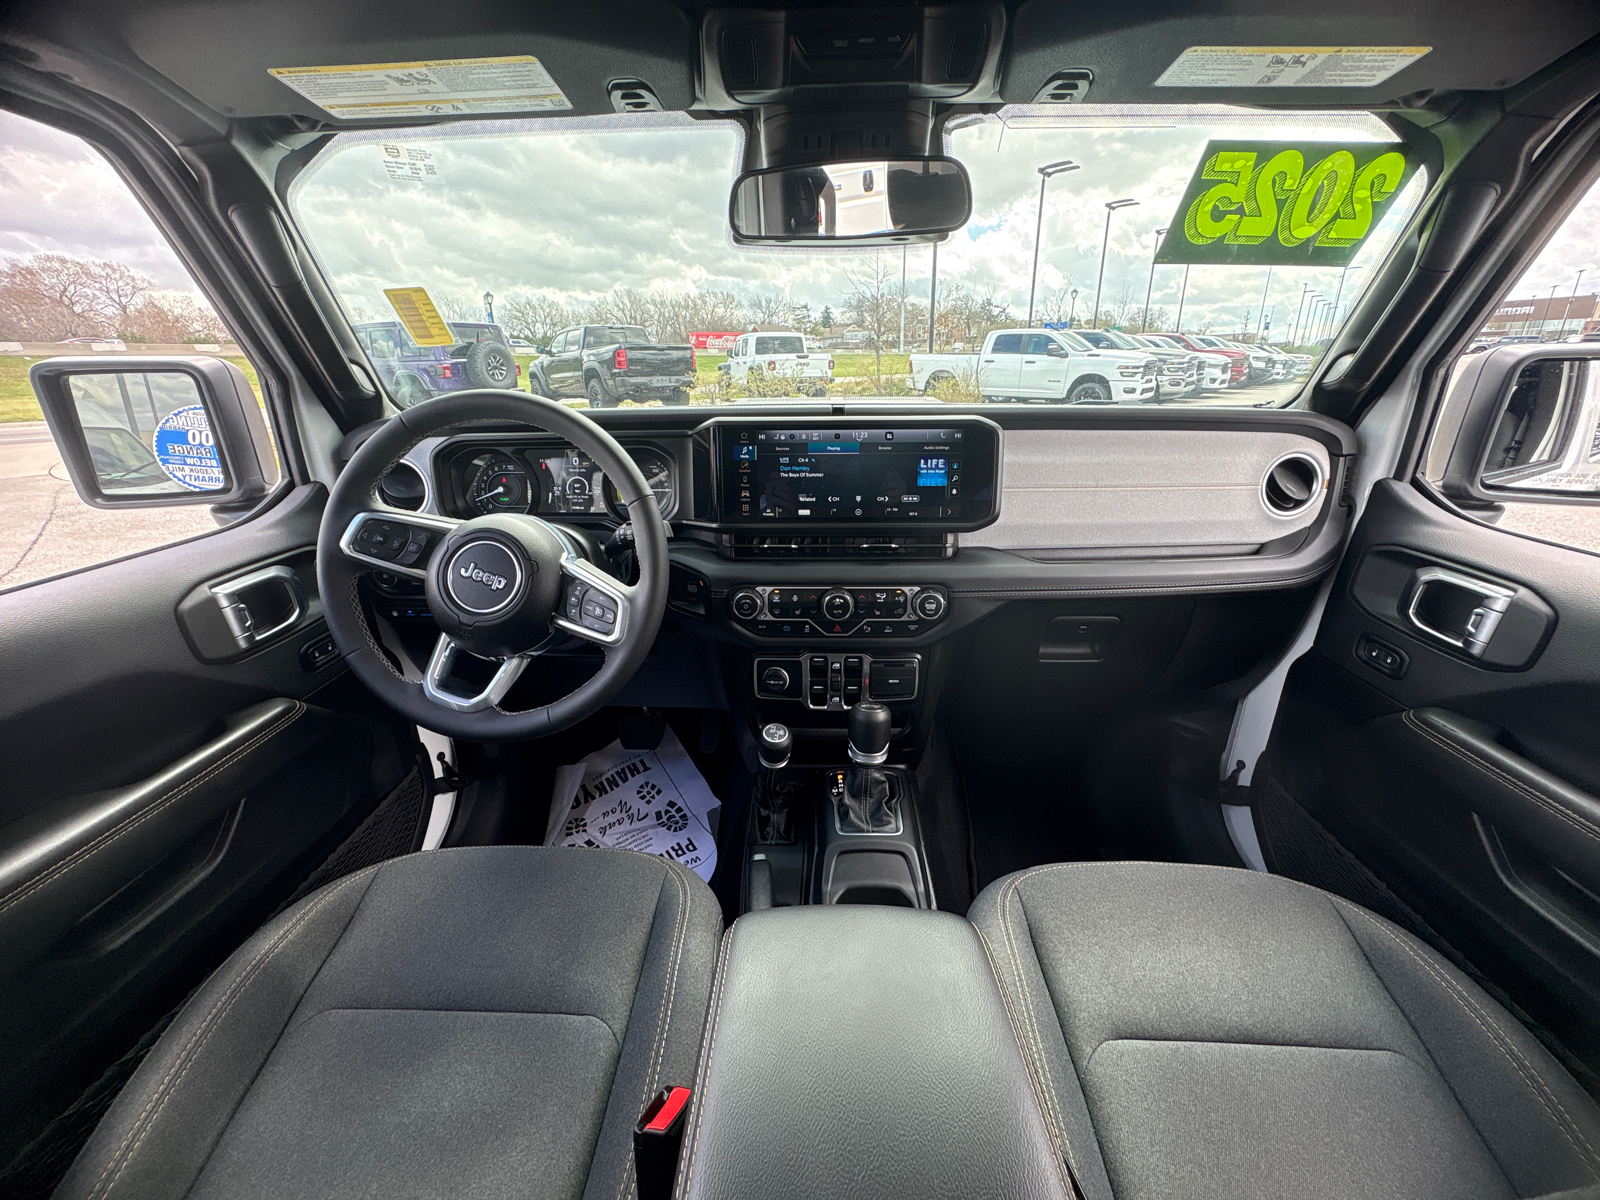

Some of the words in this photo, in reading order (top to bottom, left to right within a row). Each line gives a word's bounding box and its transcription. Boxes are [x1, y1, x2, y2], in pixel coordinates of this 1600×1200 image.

[920, 459, 946, 469] LIFE
[460, 561, 507, 591] Jeep
[594, 758, 652, 800] THANK
[598, 808, 649, 838] Thank
